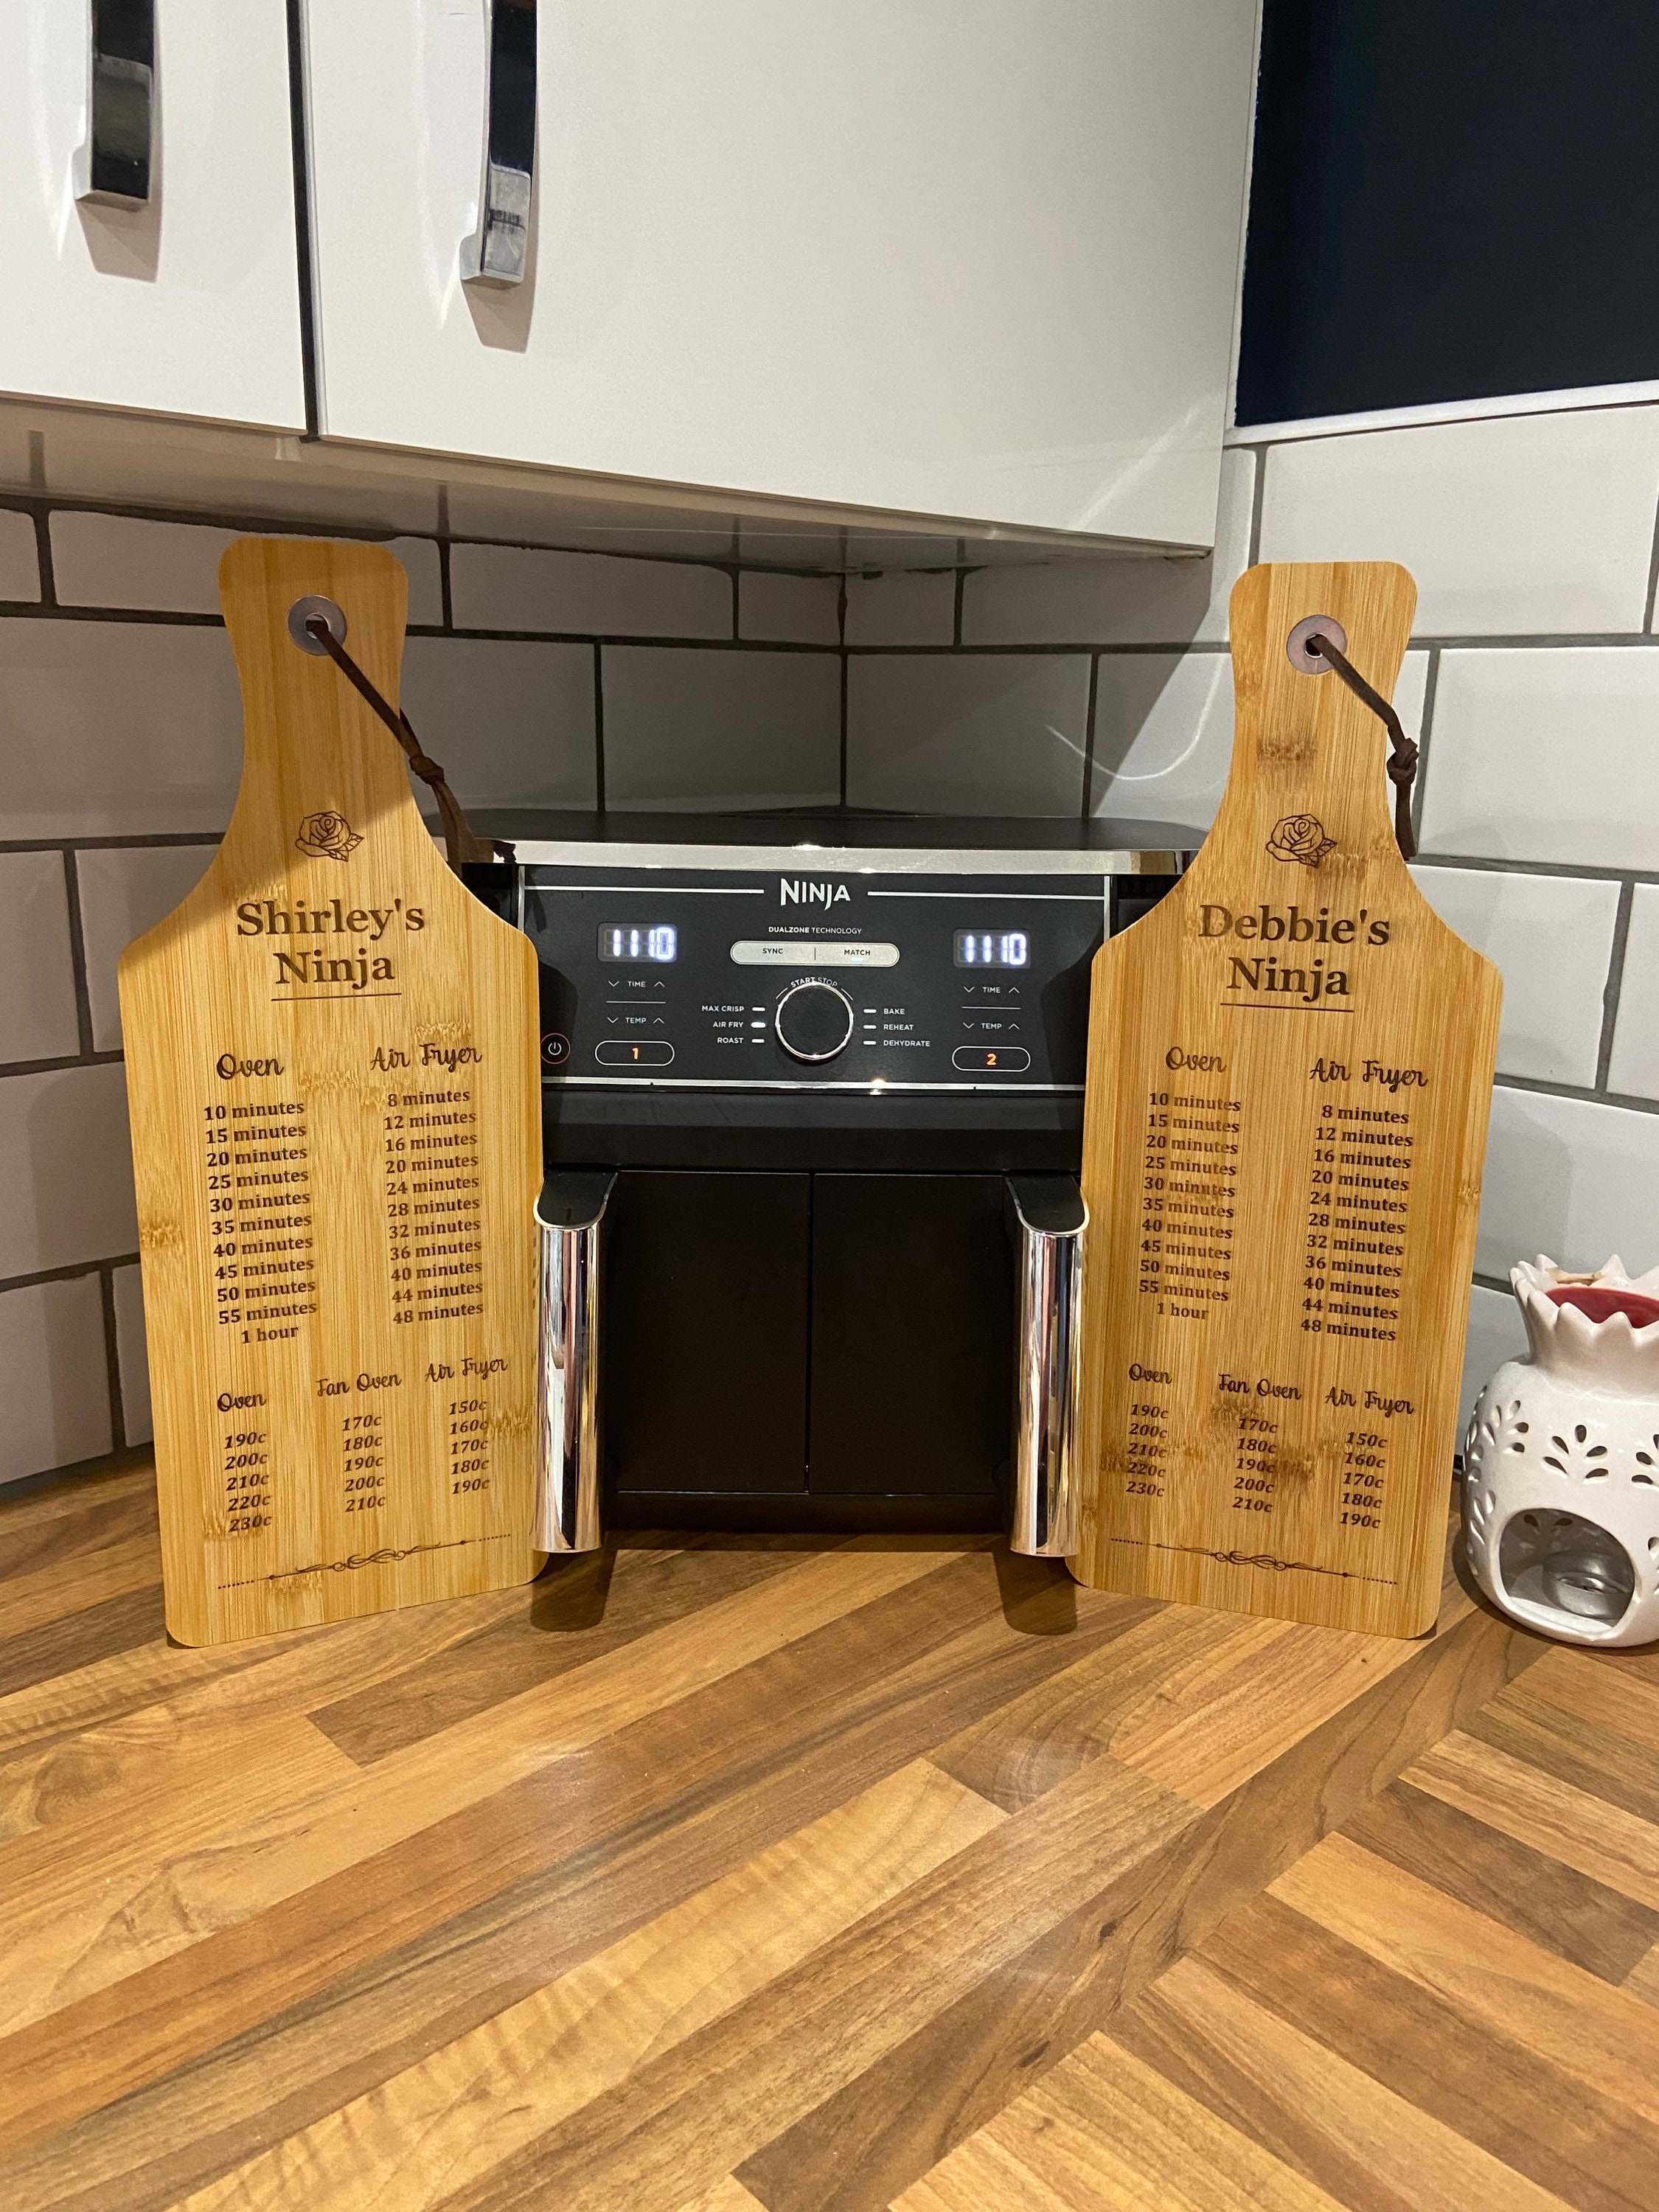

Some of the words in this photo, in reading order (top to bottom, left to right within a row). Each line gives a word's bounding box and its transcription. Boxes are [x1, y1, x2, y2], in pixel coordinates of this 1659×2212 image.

[779, 878, 851, 911] NINJA
[237, 899, 425, 940] Shirley's
[1198, 905, 1390, 945] Debbie's
[812, 927, 862, 935] TECHNOLOGY
[273, 948, 395, 990] Ninja
[790, 976, 816, 989] START
[818, 976, 838, 987] STOP
[1227, 957, 1350, 1003] Ninja
[370, 1047, 410, 1071] Air
[420, 1043, 482, 1073] Fryer
[632, 1047, 639, 1060] 1
[987, 1053, 997, 1066] 2
[1166, 1047, 1226, 1072] Oven
[217, 1054, 285, 1079] Oven
[1310, 1058, 1351, 1082] Air
[1362, 1060, 1428, 1093] Fryer
[389, 1094, 397, 1107] 8
[403, 1091, 470, 1105] minutes
[1150, 1093, 1169, 1105] 10
[1175, 1097, 1241, 1111] minutes
[204, 1106, 226, 1120] 10
[232, 1103, 305, 1119] minutes
[1322, 1105, 1332, 1118] 8
[1338, 1107, 1408, 1124] minutes
[383, 1116, 403, 1130] 12
[409, 1113, 476, 1127] minutes
[206, 1128, 227, 1144] 15
[234, 1125, 306, 1141] minutes
[386, 1138, 405, 1152] 16
[411, 1134, 477, 1150] minutes
[1316, 1127, 1335, 1141] 12
[1341, 1130, 1413, 1147] minutes
[207, 1152, 229, 1166] 20
[235, 1148, 307, 1164] minutes
[386, 1160, 406, 1173] 20
[411, 1156, 478, 1171] minutes
[1314, 1149, 1335, 1162] 16
[1340, 1152, 1411, 1169] minutes
[209, 1174, 231, 1189] 25
[237, 1171, 308, 1187] minutes
[387, 1182, 408, 1195] 24
[413, 1178, 479, 1193] minutes
[1312, 1170, 1332, 1183] 20
[1338, 1174, 1409, 1191] minutes
[210, 1197, 232, 1212] 30
[238, 1193, 310, 1209] minutes
[388, 1203, 408, 1217] 28
[414, 1199, 479, 1214] minutes
[1144, 1197, 1164, 1211] 35
[1169, 1203, 1234, 1218] minutes
[1310, 1192, 1331, 1206] 24
[1337, 1195, 1407, 1212] minutes
[212, 1220, 234, 1235] 35
[240, 1215, 311, 1232] minutes
[389, 1225, 409, 1239] 32
[415, 1220, 480, 1236] minutes
[1142, 1219, 1162, 1231] 40
[1167, 1223, 1232, 1239] minutes
[1309, 1213, 1329, 1226] 28
[1335, 1217, 1405, 1234] minutes
[214, 1242, 236, 1257] 40
[242, 1238, 313, 1254] minutes
[391, 1246, 410, 1260] 36
[416, 1242, 481, 1257] minutes
[1141, 1240, 1161, 1252] 45
[1166, 1244, 1231, 1259] minutes
[1307, 1234, 1326, 1248] 32
[1333, 1238, 1403, 1256] minutes
[215, 1265, 237, 1279] 45
[243, 1260, 313, 1276] minutes
[392, 1267, 411, 1281] 40
[417, 1262, 481, 1279] minutes
[1141, 1259, 1160, 1273] 50
[1166, 1265, 1229, 1281] minutes
[1306, 1256, 1326, 1269] 36
[1332, 1260, 1402, 1277] minutes
[218, 1287, 240, 1302] 50
[245, 1281, 315, 1298] minutes
[392, 1290, 412, 1303] 44
[417, 1284, 482, 1300] minutes
[1139, 1280, 1158, 1293] 55
[1164, 1285, 1228, 1301] minutes
[1304, 1277, 1324, 1290] 40
[1330, 1281, 1399, 1298] minutes
[219, 1309, 240, 1324] 55
[247, 1304, 316, 1321] minutes
[393, 1310, 413, 1324] 48
[418, 1304, 483, 1321] minutes
[1158, 1303, 1164, 1314] 1
[1171, 1304, 1208, 1319] hour
[1302, 1298, 1323, 1311] 44
[1329, 1302, 1397, 1319] minutes
[241, 1330, 250, 1343] 1
[257, 1327, 299, 1341] hour
[1301, 1319, 1321, 1332] 48
[1327, 1323, 1396, 1340] minutes
[425, 1363, 454, 1382] Air
[461, 1357, 508, 1380] Fryer
[1129, 1363, 1172, 1384] Oven
[316, 1379, 349, 1397] Fan
[357, 1374, 402, 1391] Oven
[1219, 1374, 1251, 1394] Fan
[1256, 1379, 1303, 1399] Oven
[218, 1393, 266, 1412] Oven
[450, 1399, 487, 1415] 150c
[1326, 1387, 1356, 1407] Air
[1365, 1391, 1414, 1418] Fryer
[1131, 1405, 1168, 1419] 190c
[343, 1415, 381, 1431] 170c
[451, 1419, 488, 1434] 160c
[1129, 1423, 1167, 1438] 200c
[1238, 1418, 1278, 1433] 170c
[225, 1432, 266, 1449] 190c
[344, 1436, 382, 1451] 180c
[451, 1439, 488, 1454] 170c
[1237, 1438, 1276, 1453] 180c
[1346, 1432, 1387, 1447] 150c
[225, 1453, 268, 1470] 200c
[344, 1455, 383, 1472] 190c
[452, 1459, 489, 1474] 180c
[1345, 1453, 1385, 1467] 160c
[226, 1474, 268, 1491] 210c
[344, 1476, 384, 1492] 200c
[453, 1479, 490, 1494] 190c
[1126, 1481, 1164, 1497] 230c
[1234, 1477, 1274, 1493] 200c
[1343, 1472, 1383, 1488] 170c
[228, 1495, 270, 1512] 220c
[346, 1495, 385, 1512] 210c
[1233, 1497, 1272, 1512] 210c
[1342, 1492, 1382, 1508] 180c
[229, 1513, 271, 1532] 230c
[1340, 1512, 1380, 1528] 190c
